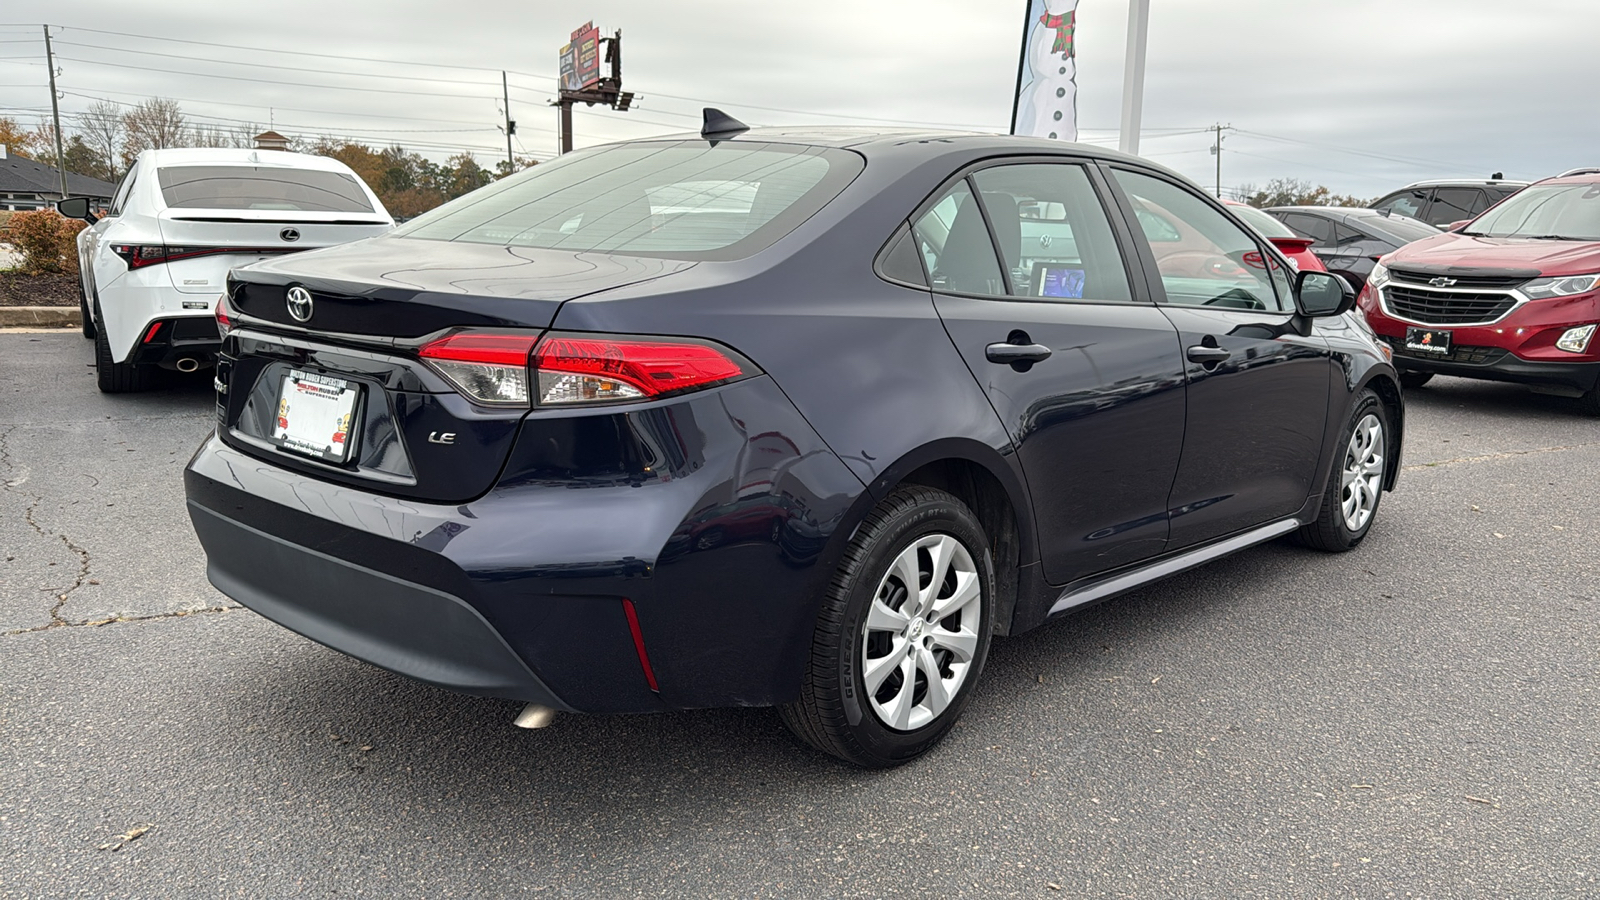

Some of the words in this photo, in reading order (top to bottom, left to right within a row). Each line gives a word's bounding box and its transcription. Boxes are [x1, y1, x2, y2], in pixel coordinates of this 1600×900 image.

[1406, 342, 1446, 352] drivebaby.com
[306, 372, 320, 383] RUBEN
[320, 376, 348, 388] SUPERSTORE
[297, 382, 319, 392] MILTON
[318, 387, 340, 397] RUBEN
[305, 390, 339, 401] SUPERSTORE
[427, 431, 457, 445] LE
[843, 613, 858, 699] GENERAL
